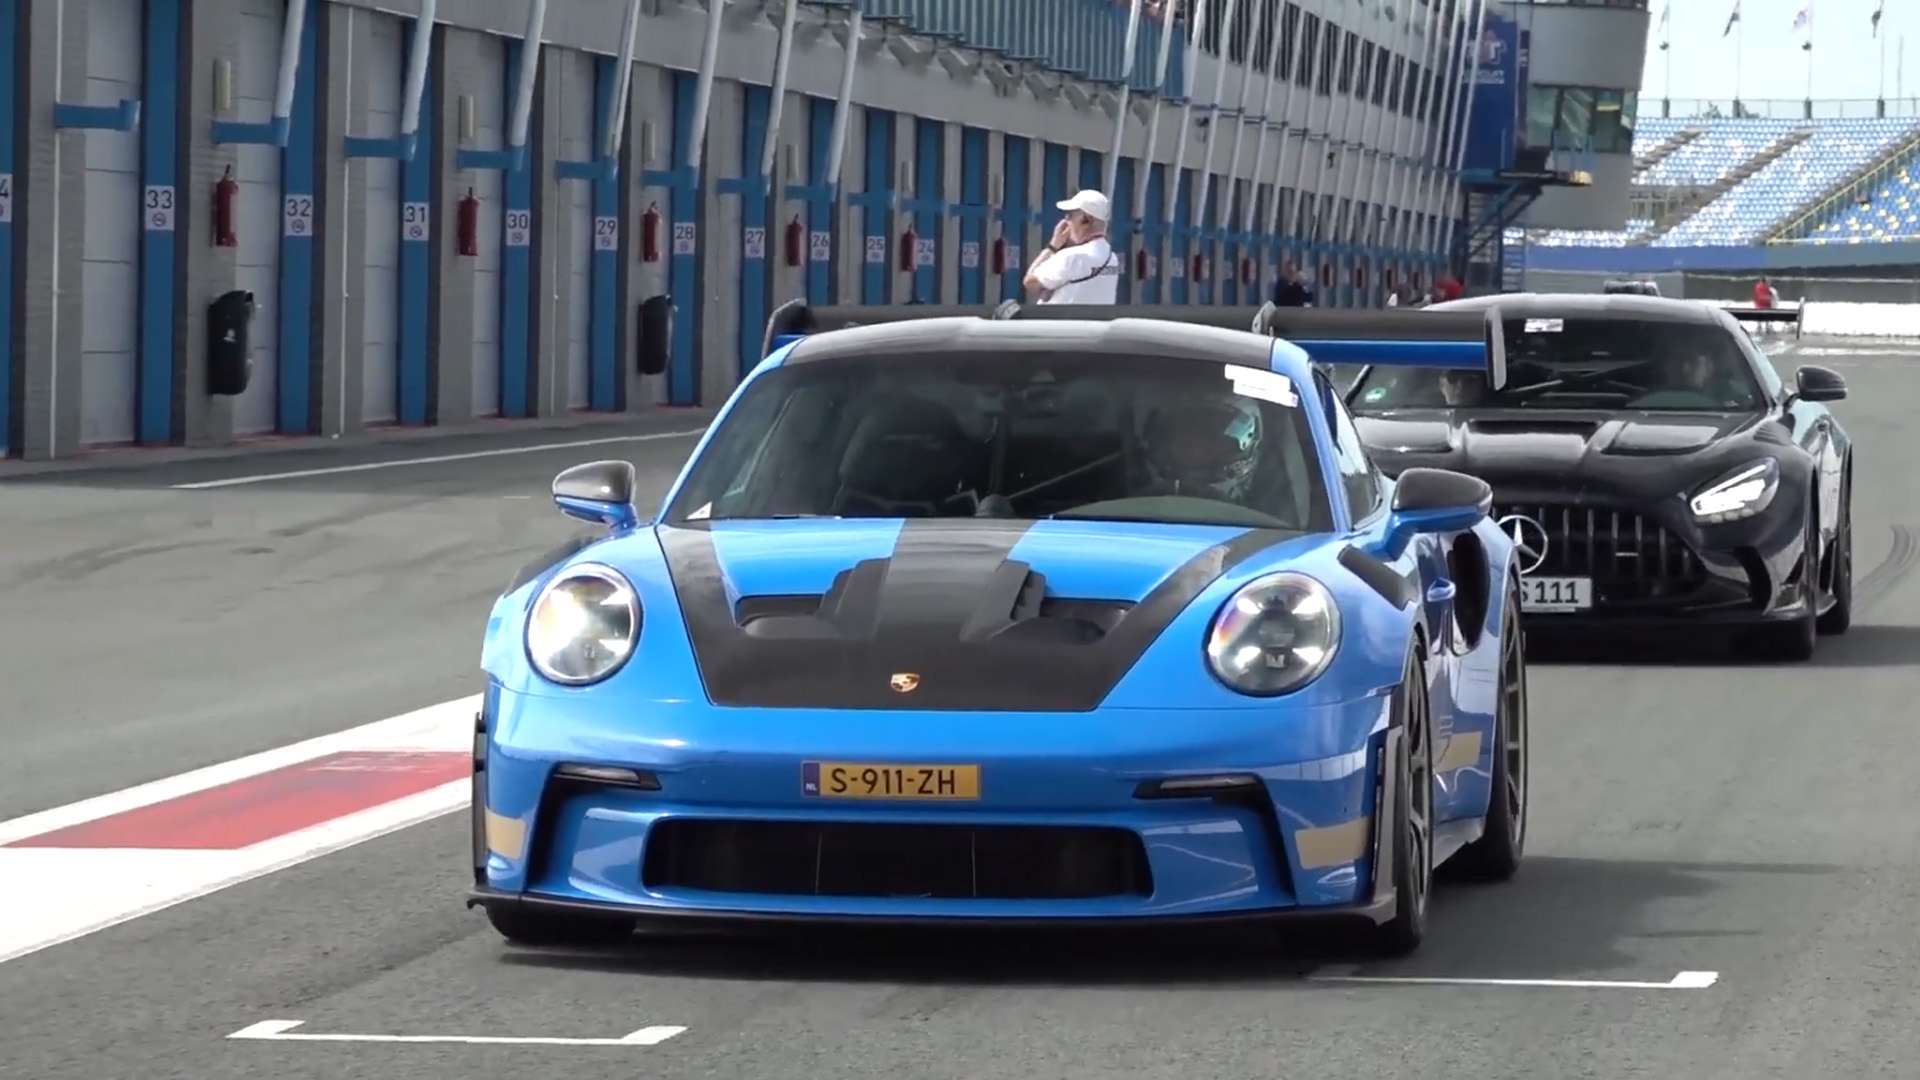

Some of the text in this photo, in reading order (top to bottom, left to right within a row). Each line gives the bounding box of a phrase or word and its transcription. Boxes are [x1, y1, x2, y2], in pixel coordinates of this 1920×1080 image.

[146, 189, 173, 209] 33
[286, 198, 311, 217] 32
[405, 205, 426, 223] 31
[507, 213, 528, 229] 30
[596, 219, 616, 236] 29
[675, 225, 694, 241] 28
[745, 230, 764, 244] 27
[811, 233, 829, 247] 26
[867, 237, 884, 250] 25
[919, 241, 934, 253] 24
[1535, 581, 1579, 604] 111
[805, 783, 817, 791] NL
[831, 767, 955, 794] S-911-ZH
